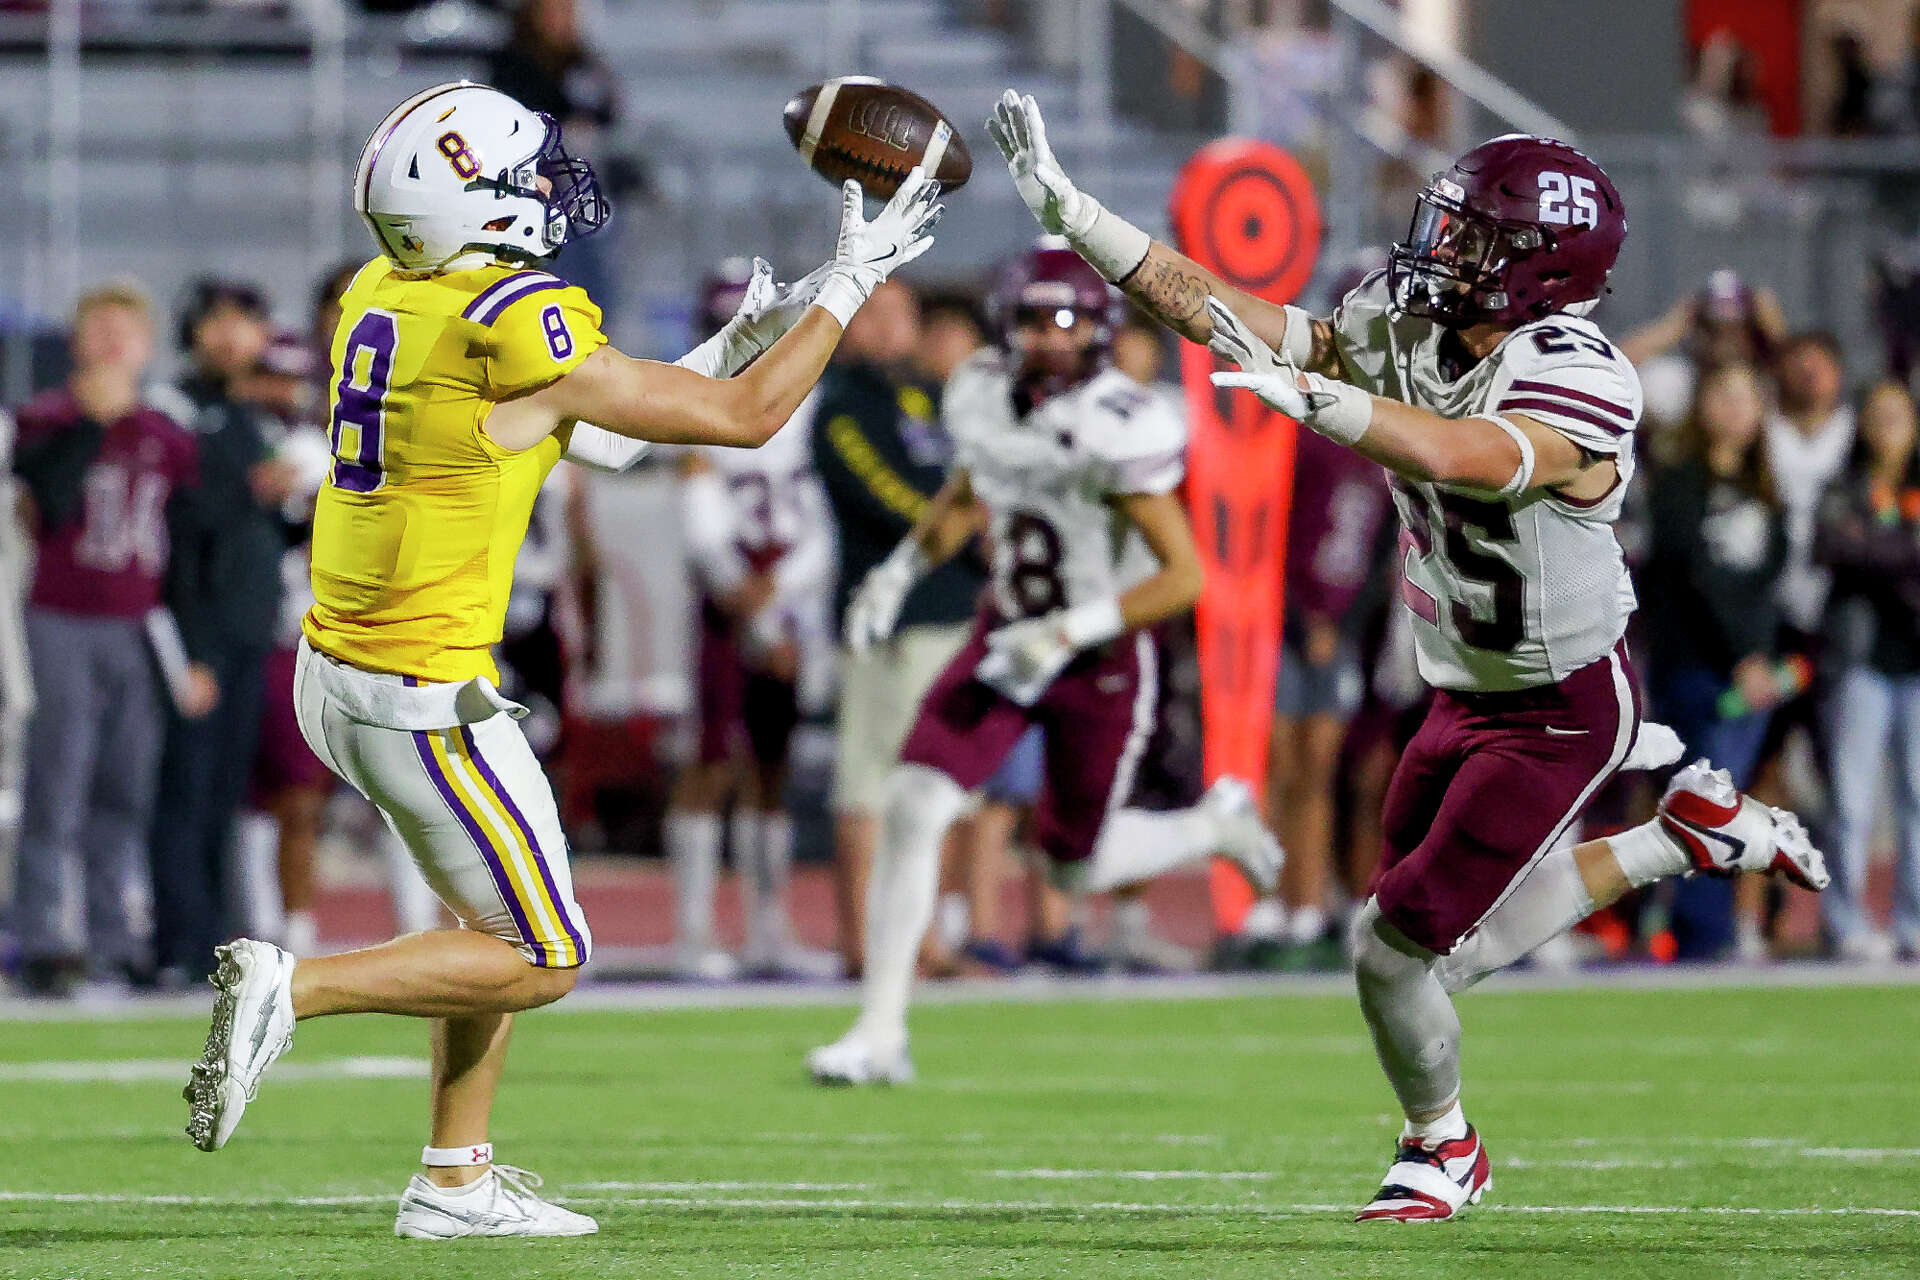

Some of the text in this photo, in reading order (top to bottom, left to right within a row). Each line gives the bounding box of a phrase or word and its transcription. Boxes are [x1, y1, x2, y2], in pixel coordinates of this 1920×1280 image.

[435, 130, 482, 181] 8
[1537, 170, 1599, 231] 25
[538, 303, 576, 363] 8
[331, 307, 399, 492] 8
